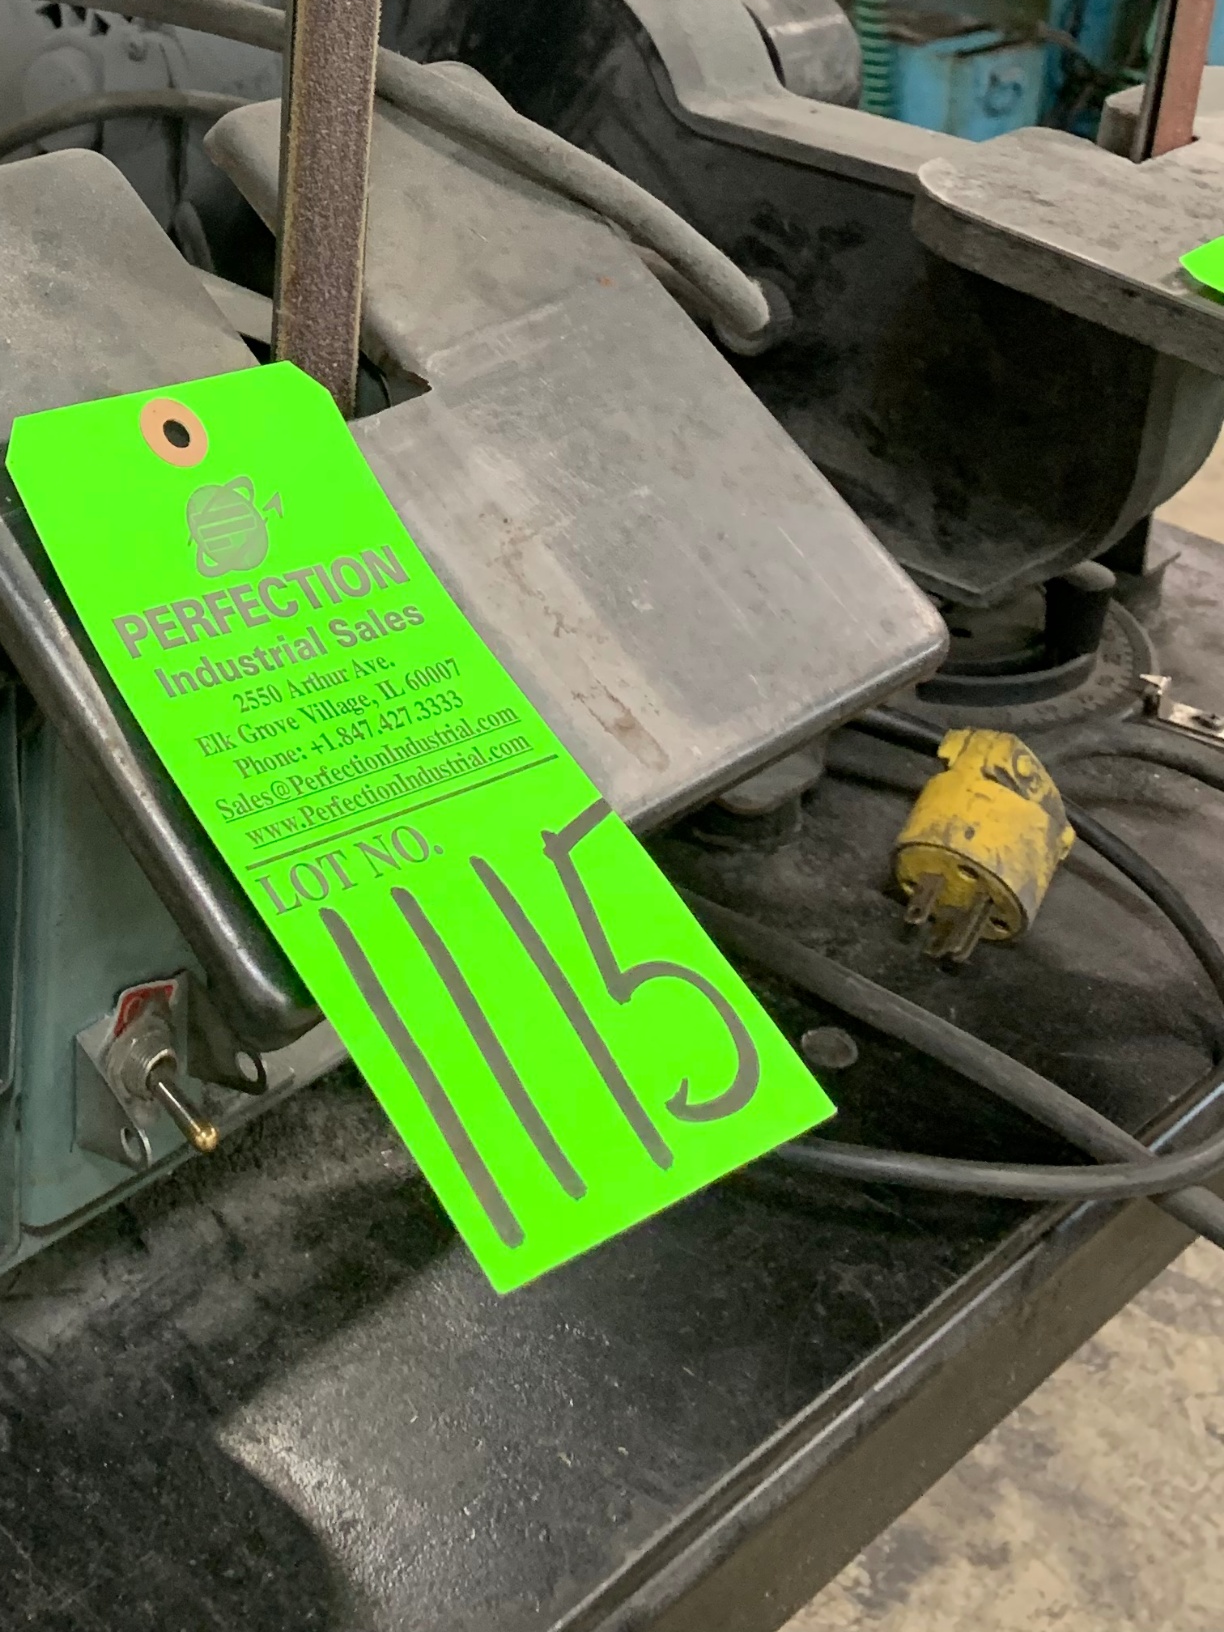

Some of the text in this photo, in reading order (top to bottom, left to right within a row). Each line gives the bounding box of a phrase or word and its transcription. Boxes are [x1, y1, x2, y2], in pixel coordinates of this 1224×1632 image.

[112, 544, 411, 660] PERFECTION
[155, 603, 425, 699] Industrial Sales
[194, 657, 463, 759] Elk Grove Village, IL 60007
[232, 652, 396, 715] 2550 Arthur Ave.
[233, 689, 465, 779] Phone: +1.847.427.3333
[216, 706, 521, 821] Sales@PerfectionIndustrial.com
[243, 731, 533, 846] www.PerfectionIndustrial.com
[254, 823, 445, 917] LOT NO.
[320, 798, 762, 1250] 1115
